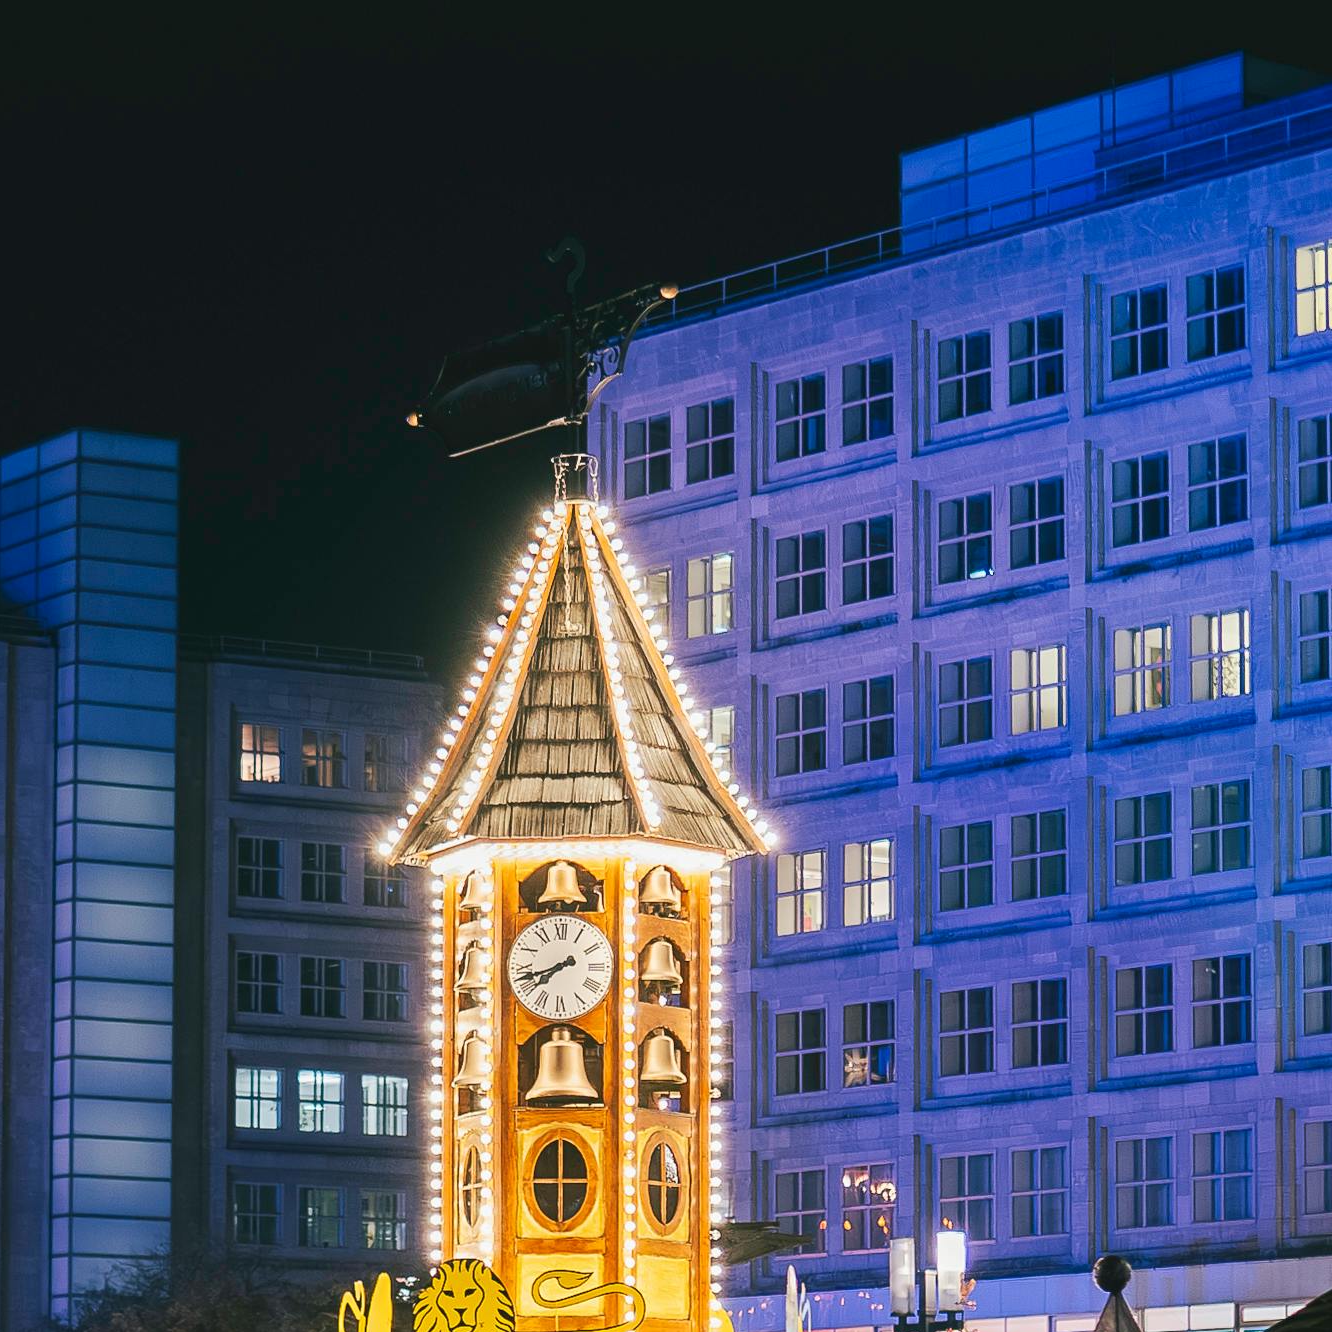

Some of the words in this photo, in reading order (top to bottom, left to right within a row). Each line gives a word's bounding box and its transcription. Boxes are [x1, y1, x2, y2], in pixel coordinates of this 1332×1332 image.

[554, 923, 568, 940] XII
[573, 928, 584, 943] I
[520, 942, 538, 957] X
[584, 942, 600, 955] II
[588, 963, 605, 971] III
[534, 990, 549, 1009] VII
[555, 995, 566, 1012] VI
[574, 992, 586, 1007] V
